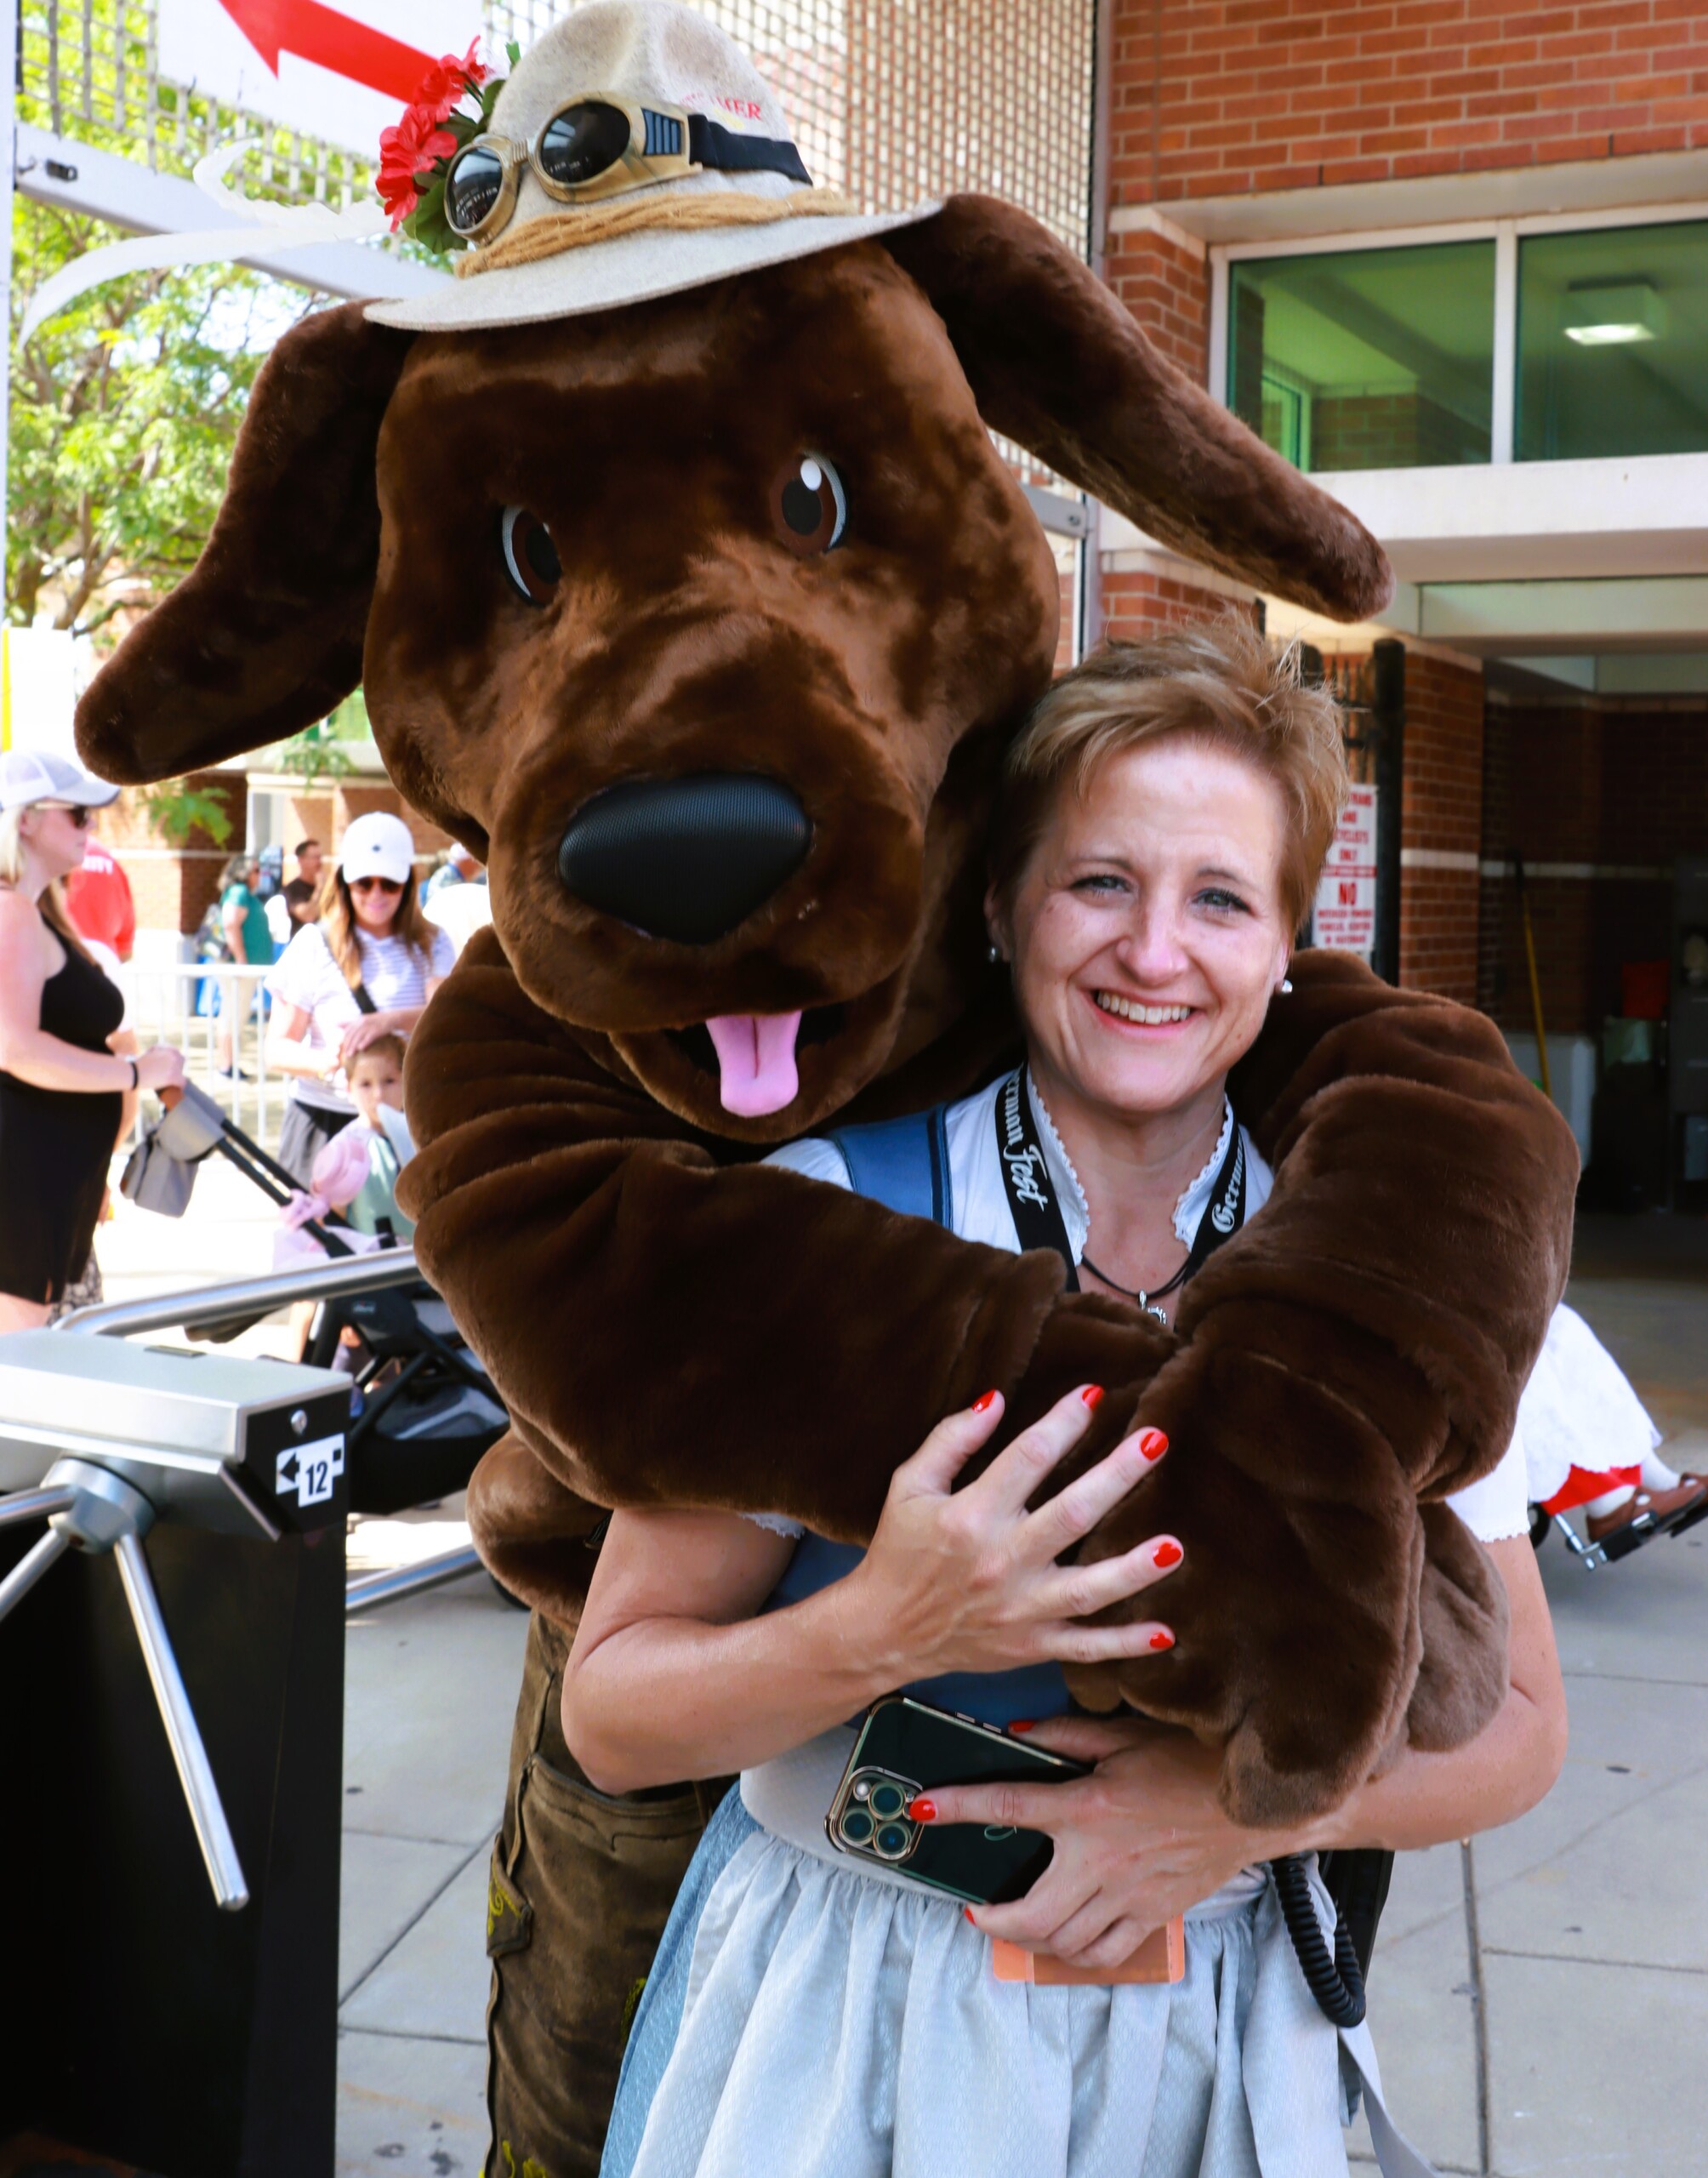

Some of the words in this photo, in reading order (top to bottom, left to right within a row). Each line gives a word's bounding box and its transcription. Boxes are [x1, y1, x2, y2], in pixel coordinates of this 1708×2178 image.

[1338, 882, 1357, 905] NO
[1005, 1067, 1023, 1146] erman
[1003, 1144, 1048, 1212] Fest
[305, 1460, 328, 1497] 12
